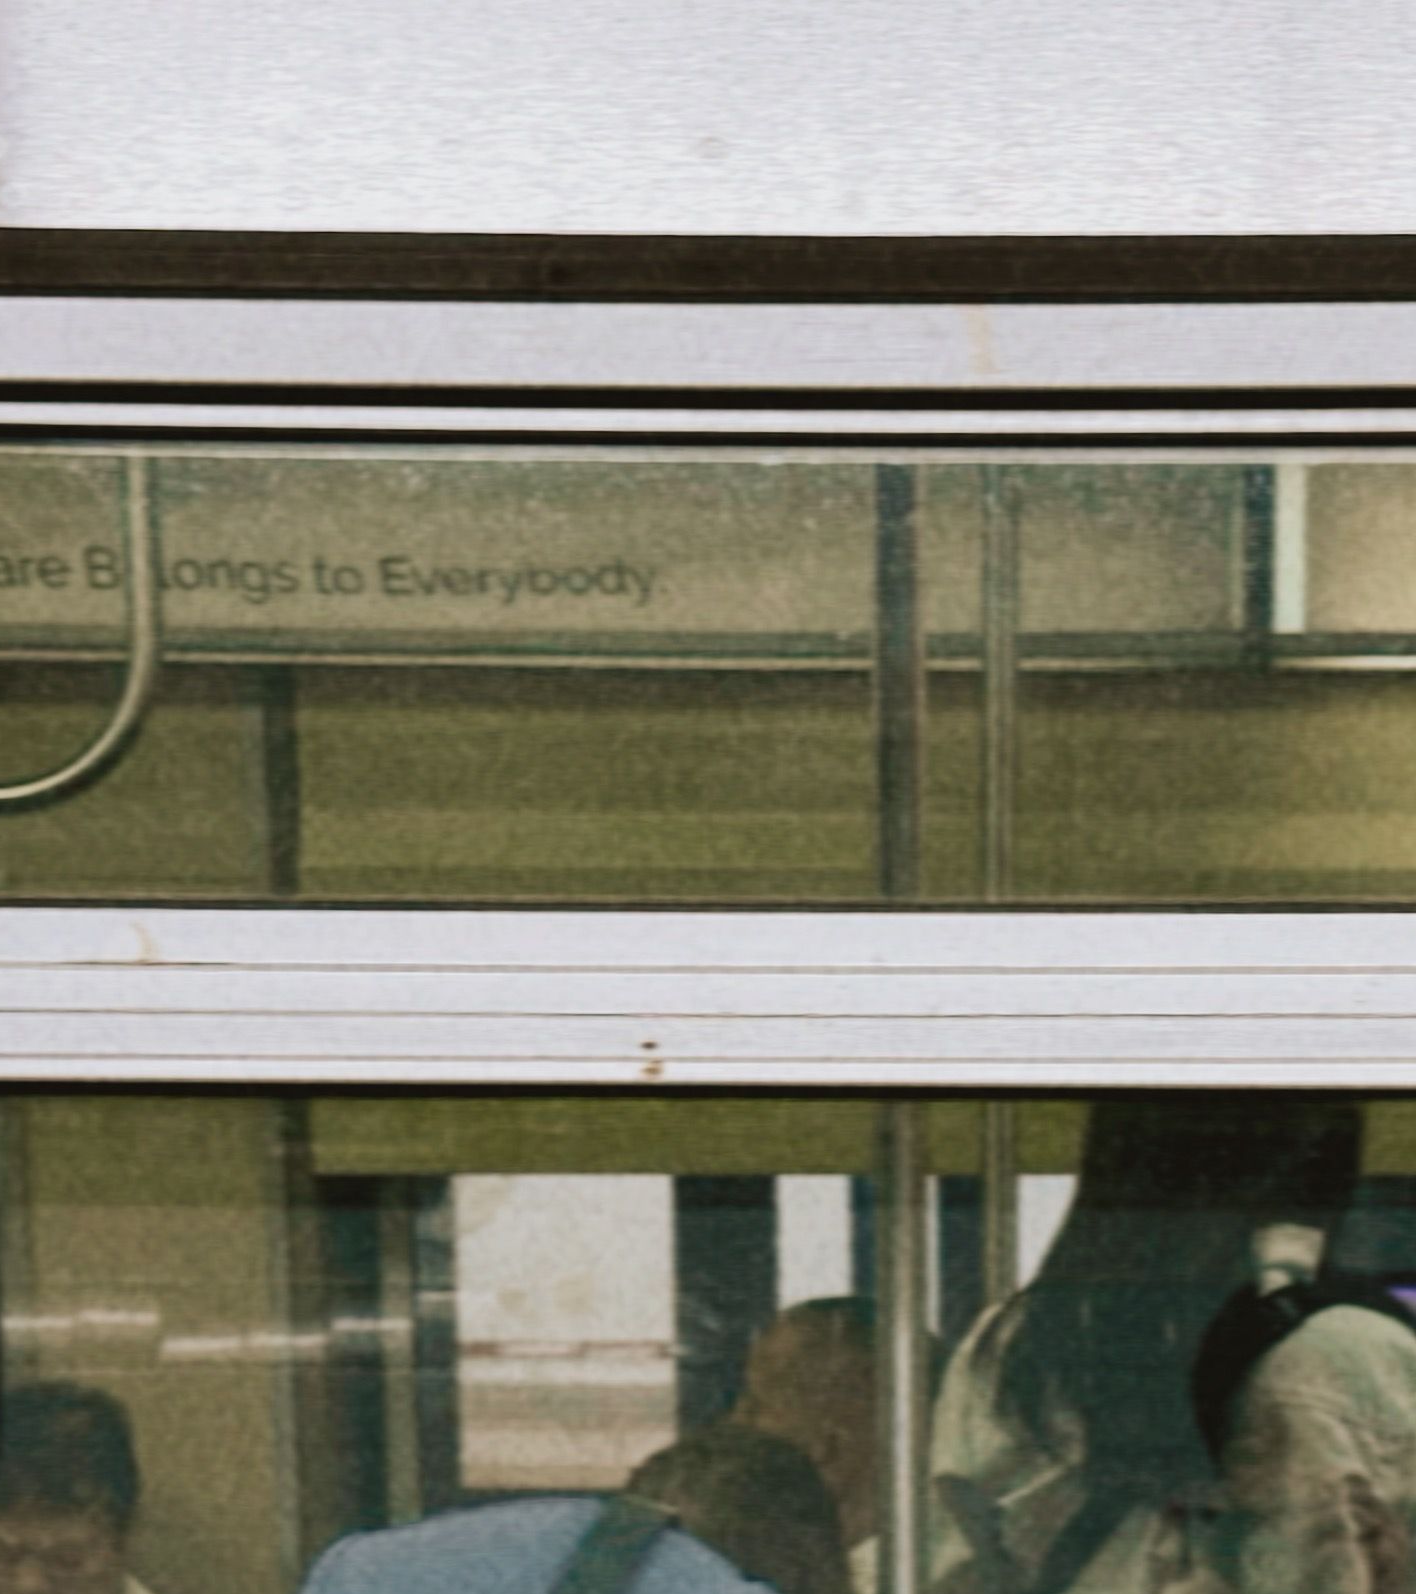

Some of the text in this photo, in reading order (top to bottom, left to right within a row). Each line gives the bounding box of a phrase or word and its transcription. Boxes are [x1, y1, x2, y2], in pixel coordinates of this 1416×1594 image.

[83, 545, 299, 603] Blongs
[314, 554, 365, 595] to
[381, 555, 670, 604] Everybody.
